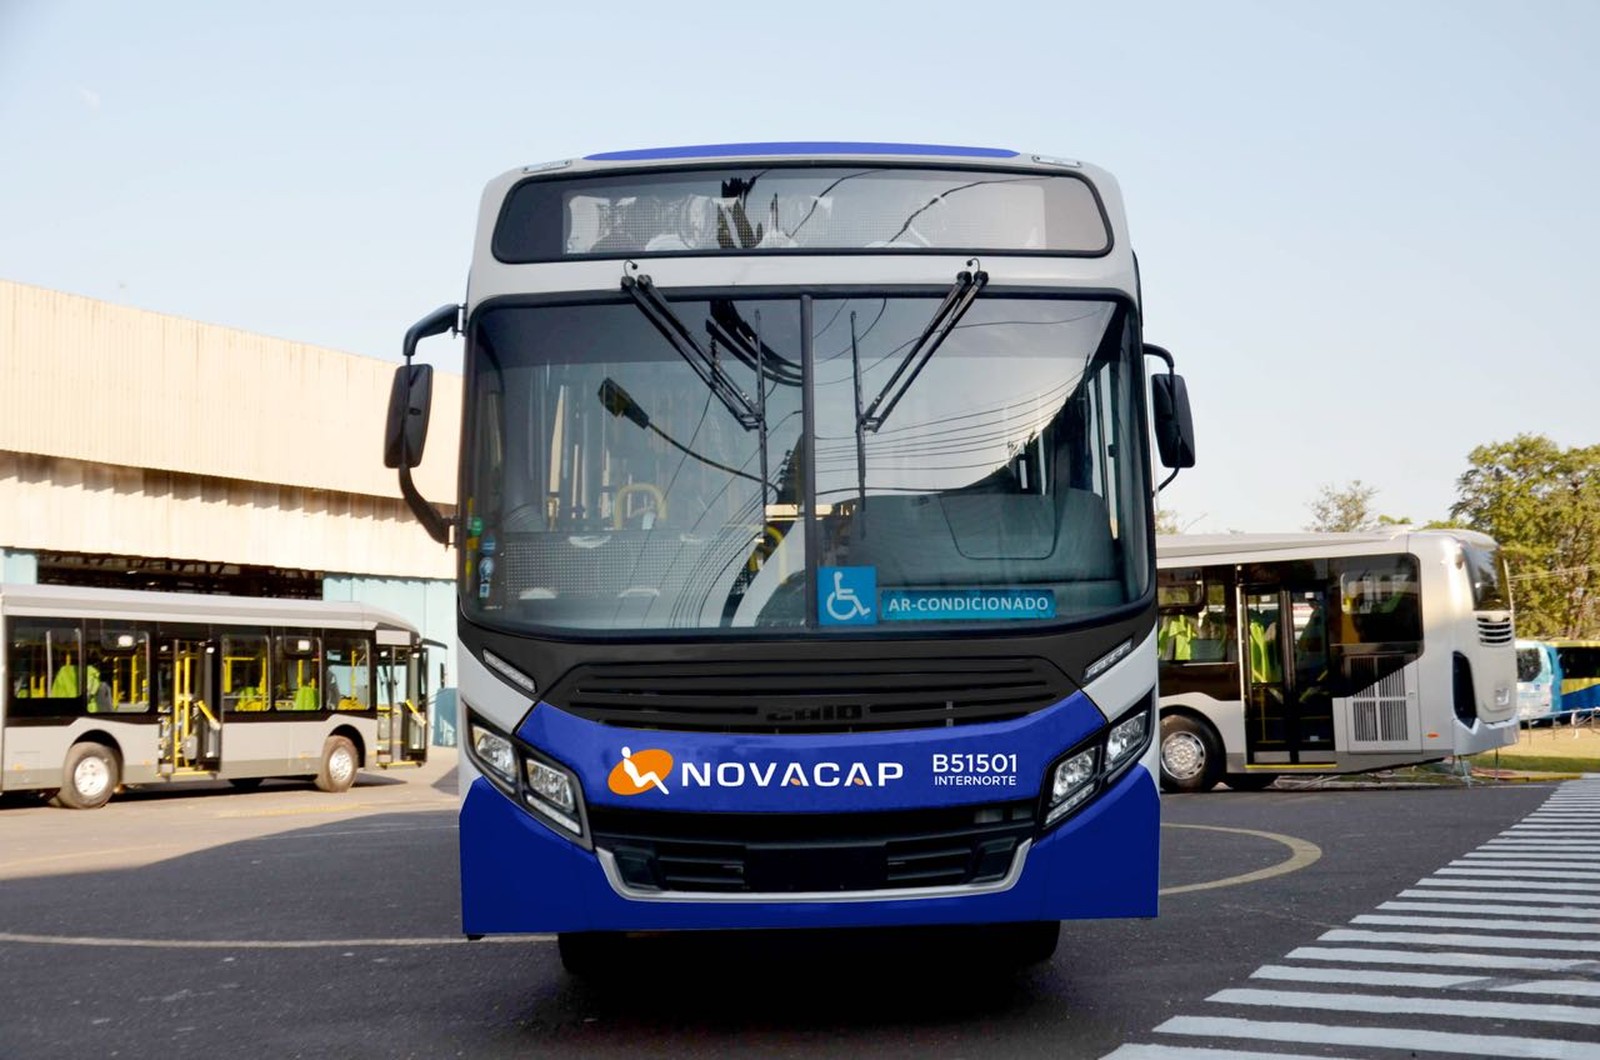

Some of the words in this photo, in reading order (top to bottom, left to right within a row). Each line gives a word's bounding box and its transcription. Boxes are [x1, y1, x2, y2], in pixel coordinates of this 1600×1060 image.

[889, 597, 1049, 613] AR-CONDICIONADO
[932, 753, 1017, 773] B51501
[681, 762, 904, 787] NOVACAP
[934, 775, 1017, 786] INTERNORTE
